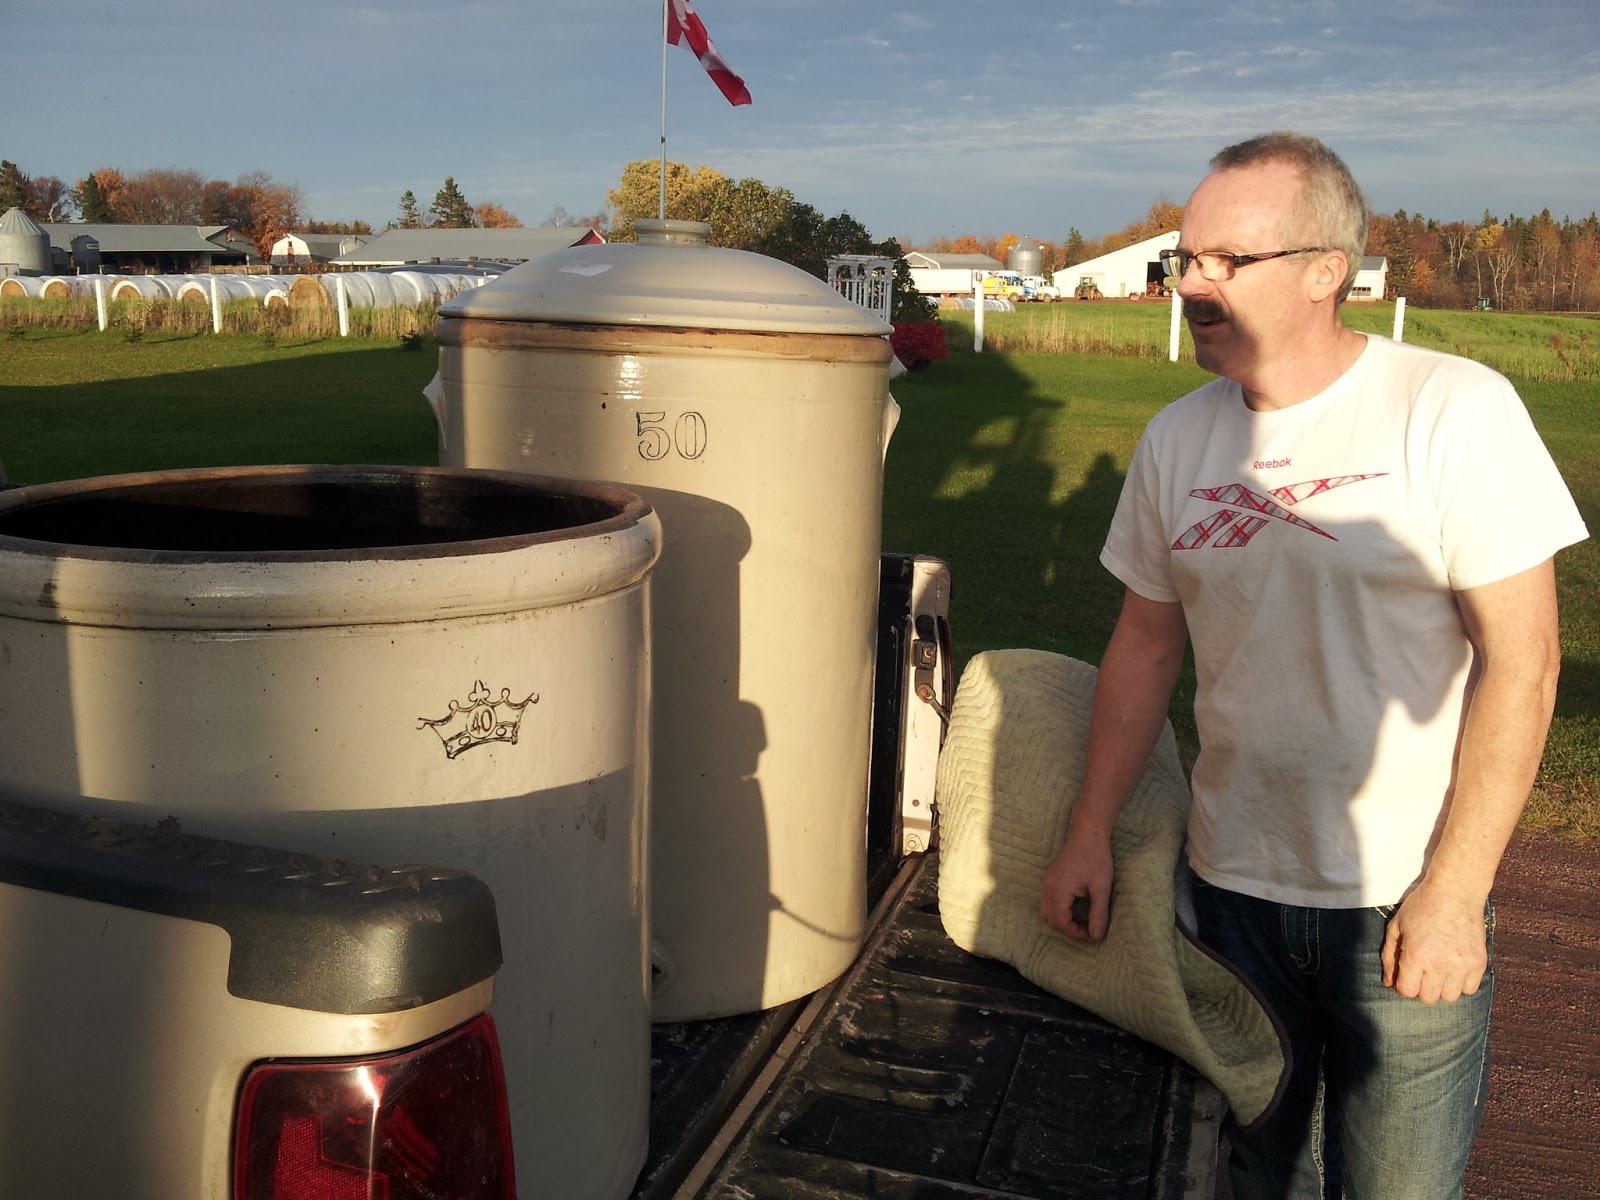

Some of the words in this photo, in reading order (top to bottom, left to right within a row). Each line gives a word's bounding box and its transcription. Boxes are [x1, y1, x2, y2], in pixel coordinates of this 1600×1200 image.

[636, 411, 707, 461] 50
[1252, 457, 1292, 471] Reebok
[470, 708, 493, 734] 40
